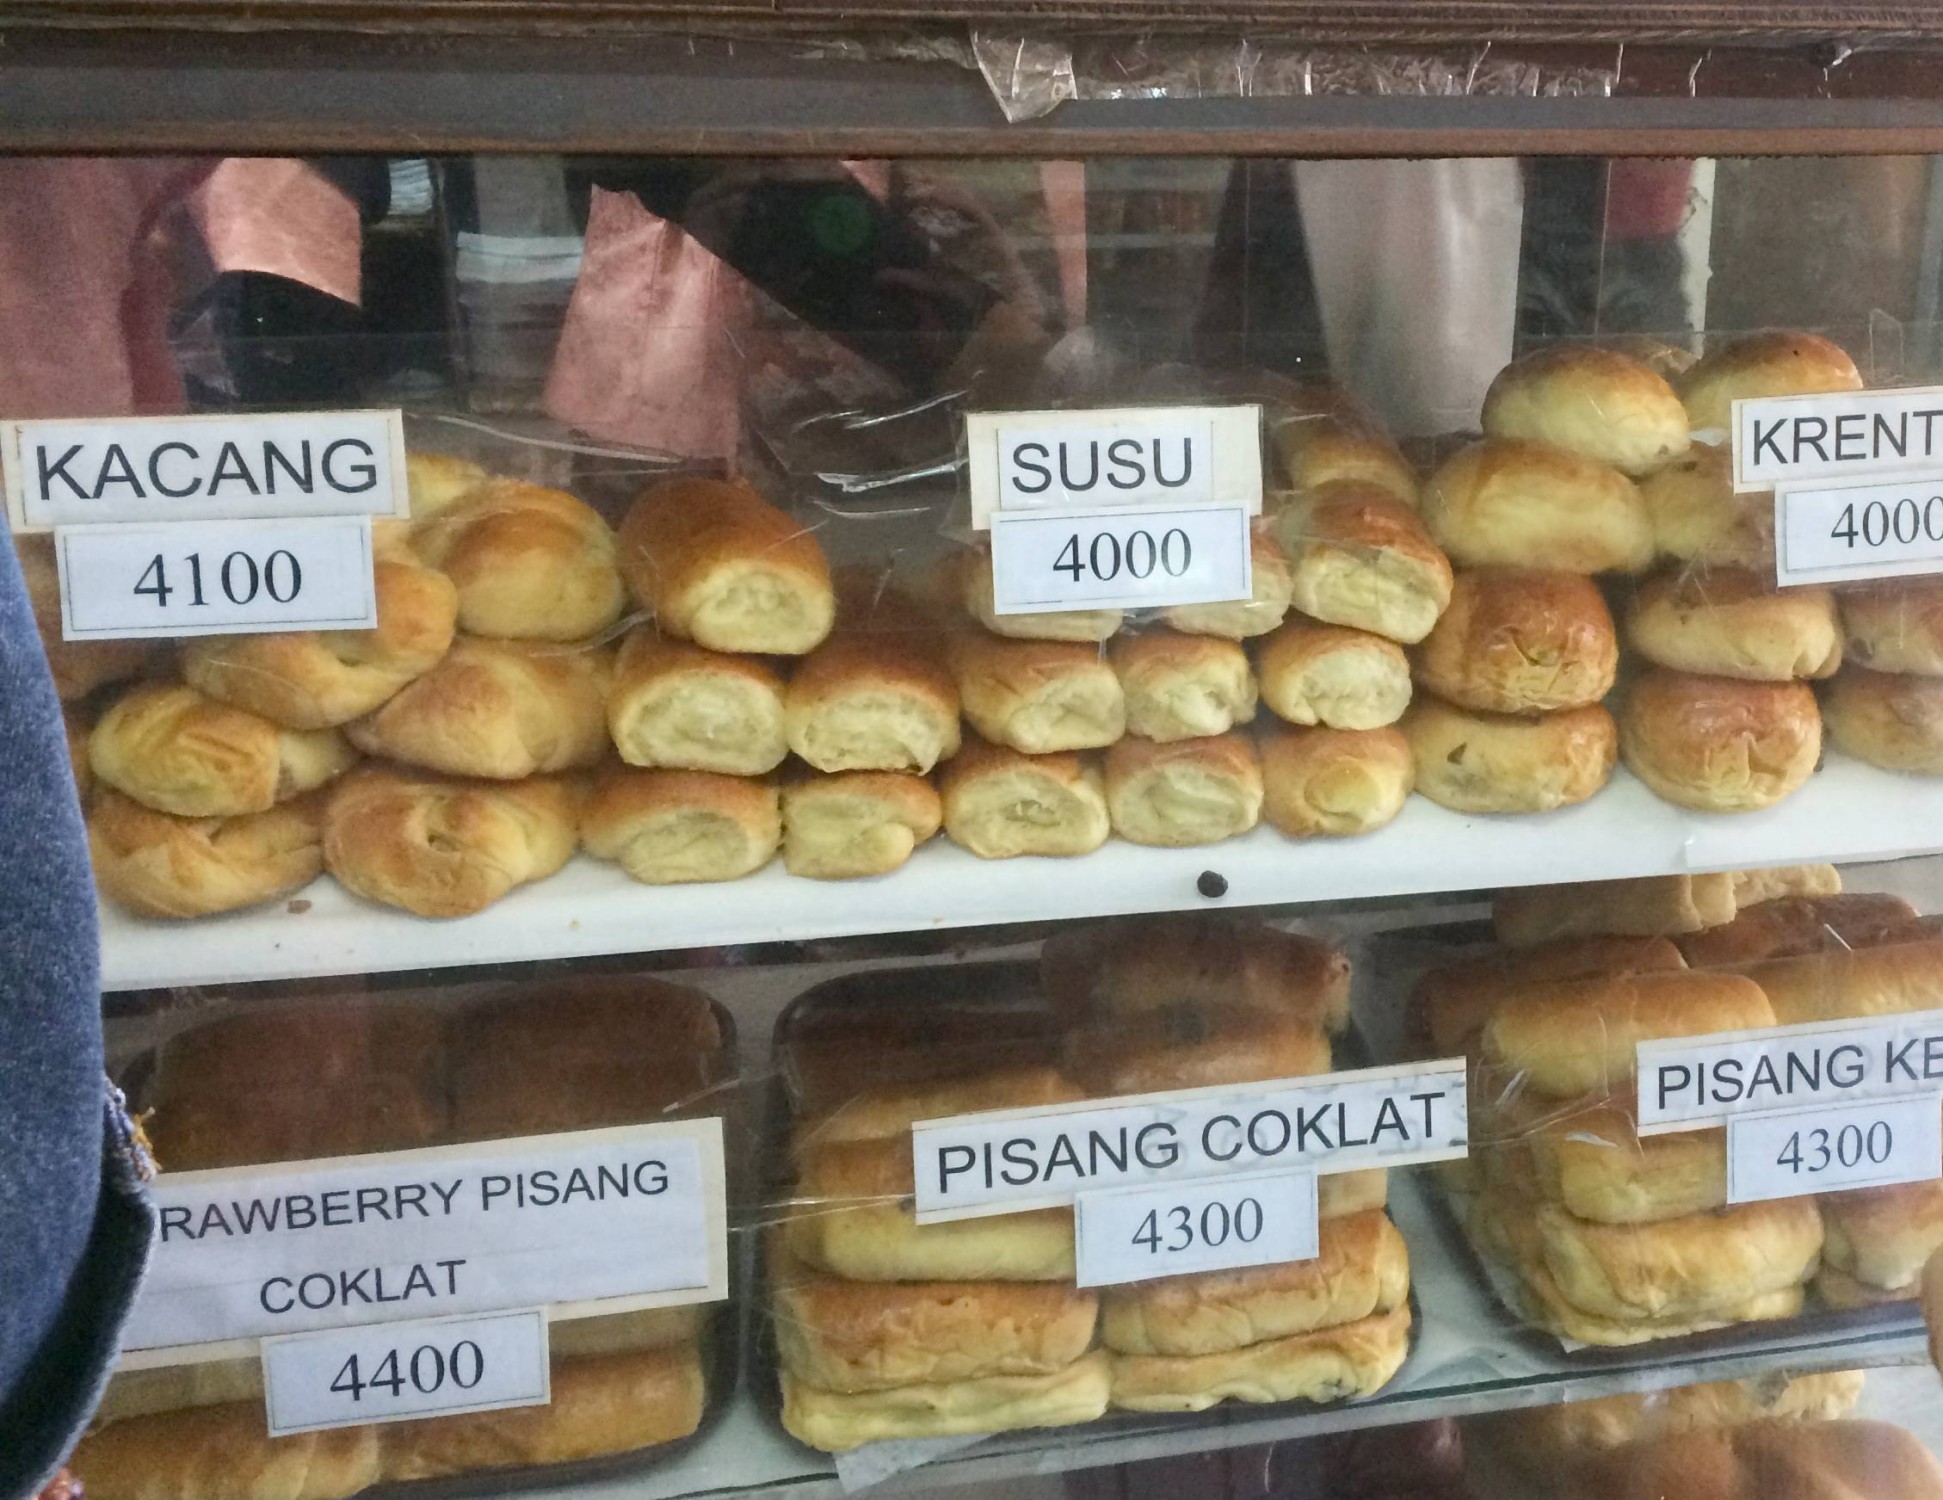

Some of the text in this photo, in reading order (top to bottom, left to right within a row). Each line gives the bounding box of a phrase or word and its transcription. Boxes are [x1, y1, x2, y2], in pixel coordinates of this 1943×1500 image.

[1011, 437, 1192, 494] SUSU
[1753, 409, 1943, 466] KRENT
[36, 438, 377, 500] KACANG
[1830, 495, 1943, 548] 4000
[133, 549, 302, 608] 4100
[1052, 528, 1192, 583] 4000
[1658, 1035, 1943, 1110] PISANG KE
[938, 1091, 1446, 1194] PISANG COKLAT
[1776, 1120, 1893, 1174] 4300
[160, 1159, 669, 1243] RAWBERRY PISANG
[1132, 1197, 1264, 1255] 4300
[260, 1259, 467, 1314] COKLAT
[329, 1338, 485, 1402] 4400
